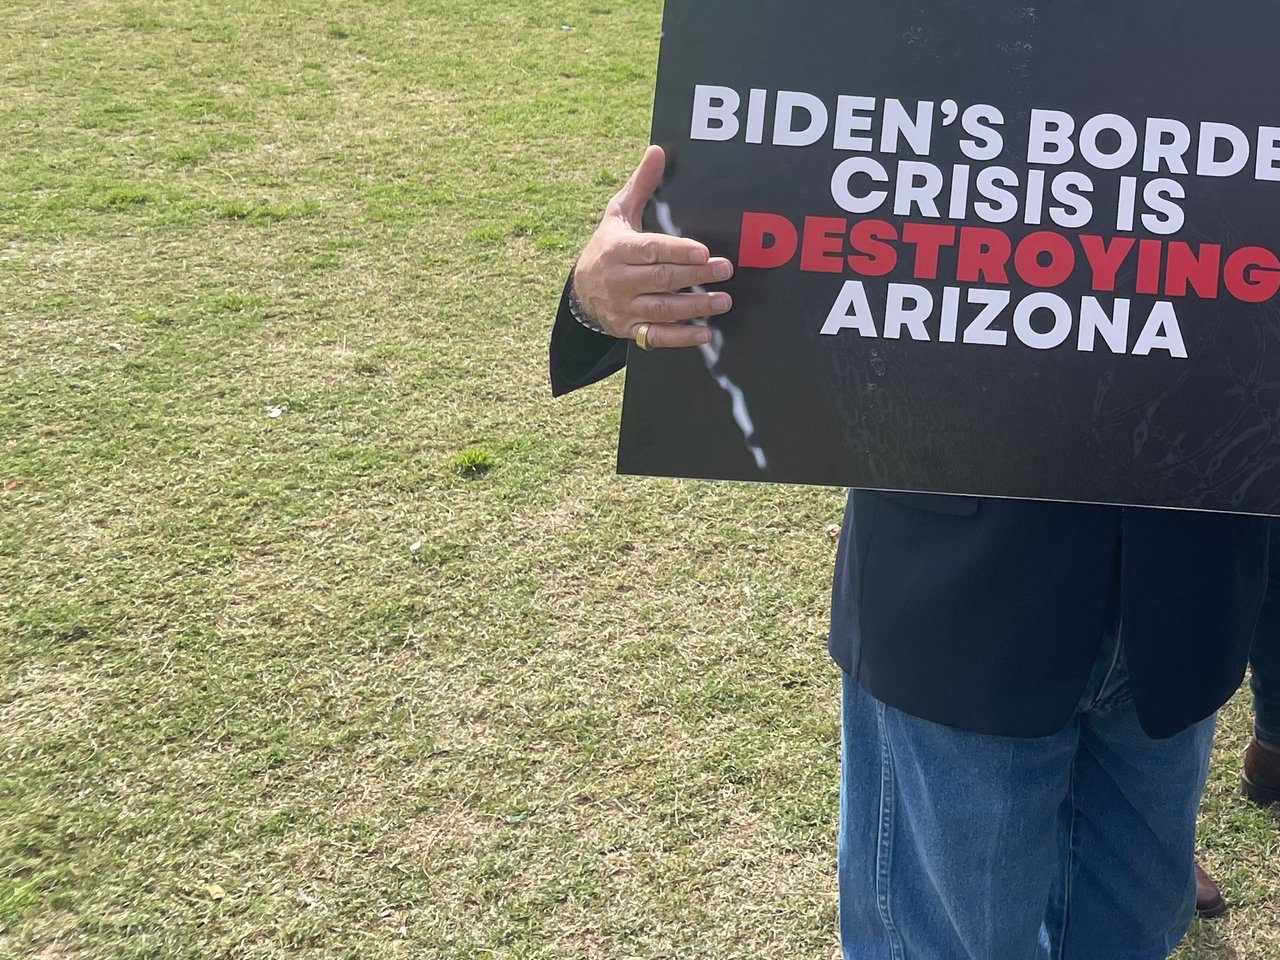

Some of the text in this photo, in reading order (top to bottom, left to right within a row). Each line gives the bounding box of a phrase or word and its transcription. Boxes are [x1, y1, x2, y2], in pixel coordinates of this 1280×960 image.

[690, 85, 1004, 160] BIDEN’S
[831, 157, 1185, 234] CRISIS IS
[739, 213, 1280, 301] DESTROYING
[820, 280, 1188, 358] ARIZONA
